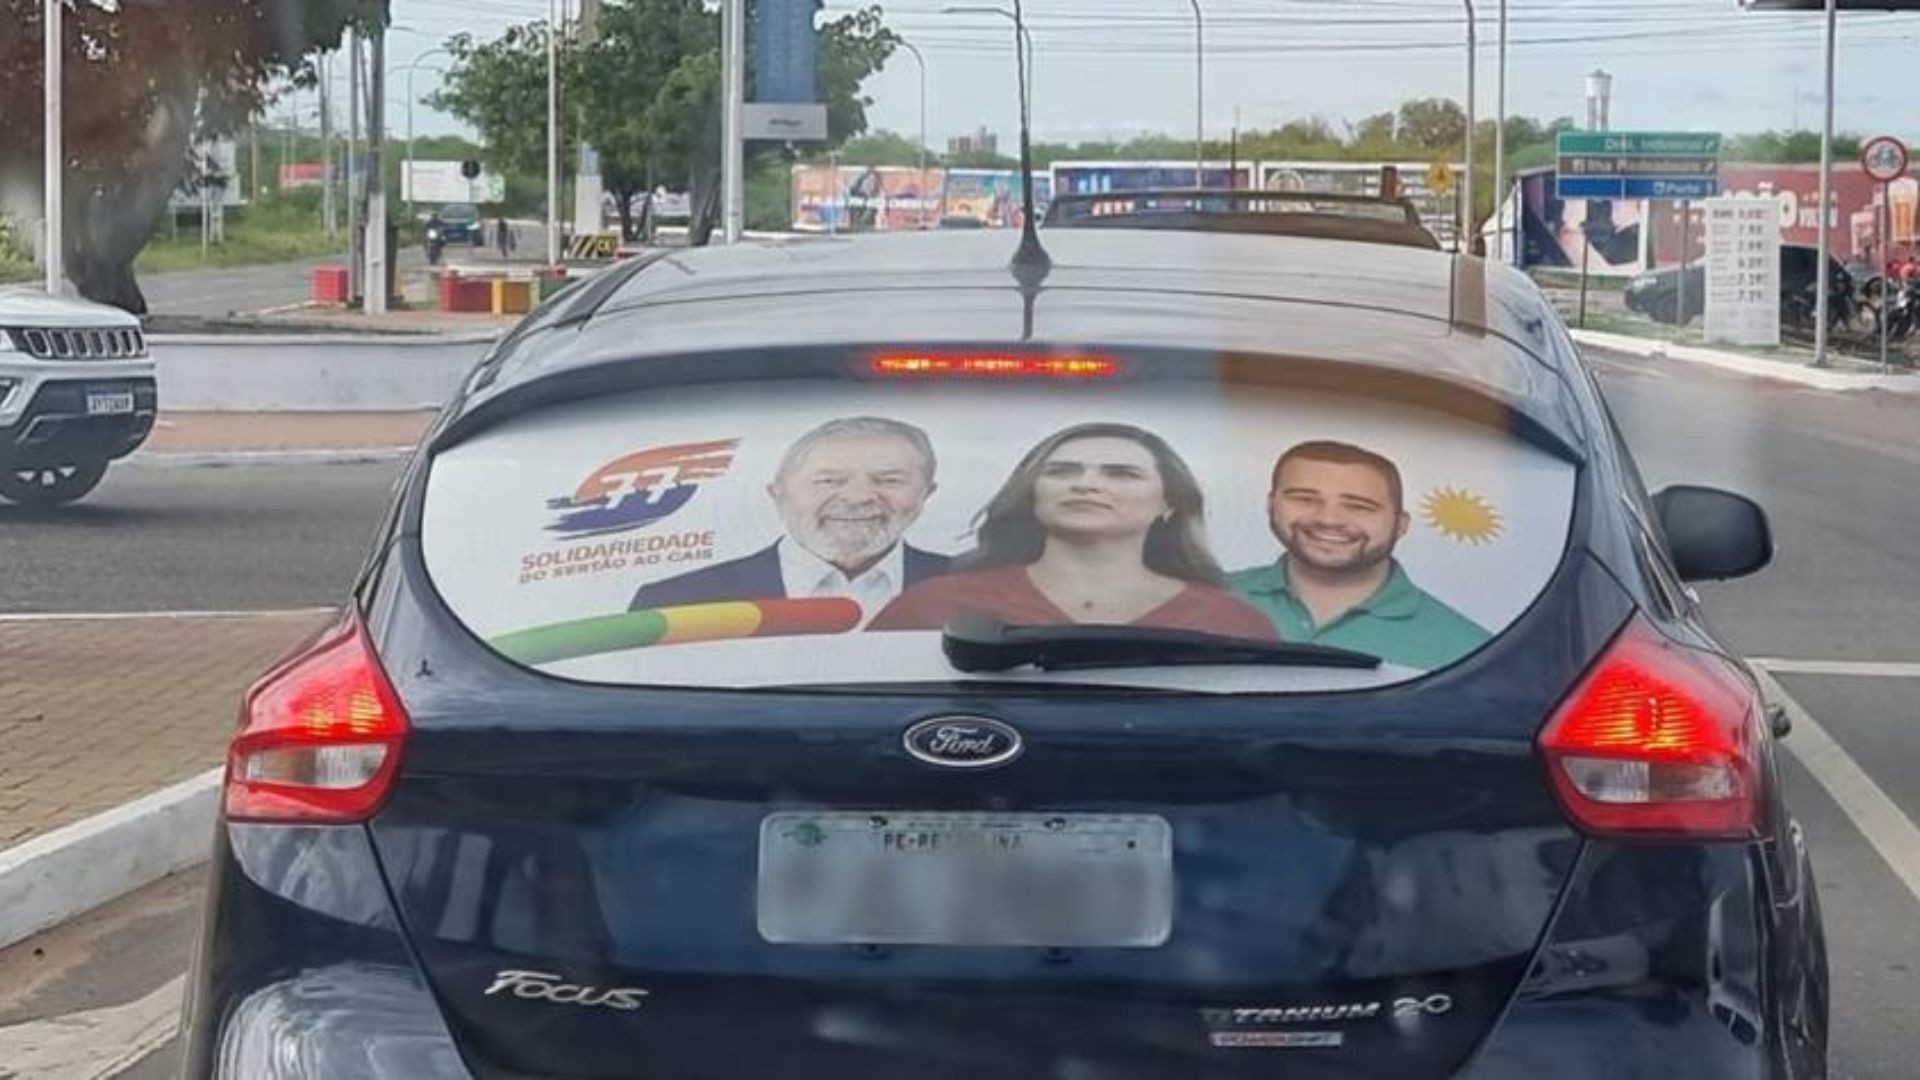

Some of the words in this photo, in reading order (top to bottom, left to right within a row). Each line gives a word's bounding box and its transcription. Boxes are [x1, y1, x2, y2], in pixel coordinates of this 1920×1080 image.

[601, 465, 681, 510] 77
[519, 568, 547, 584] DO
[551, 557, 627, 578] SERTÃO
[633, 553, 659, 567] AO
[667, 547, 713, 562] CAIS
[521, 531, 715, 571] SOLIDARIEDADE
[929, 725, 995, 754] Ford
